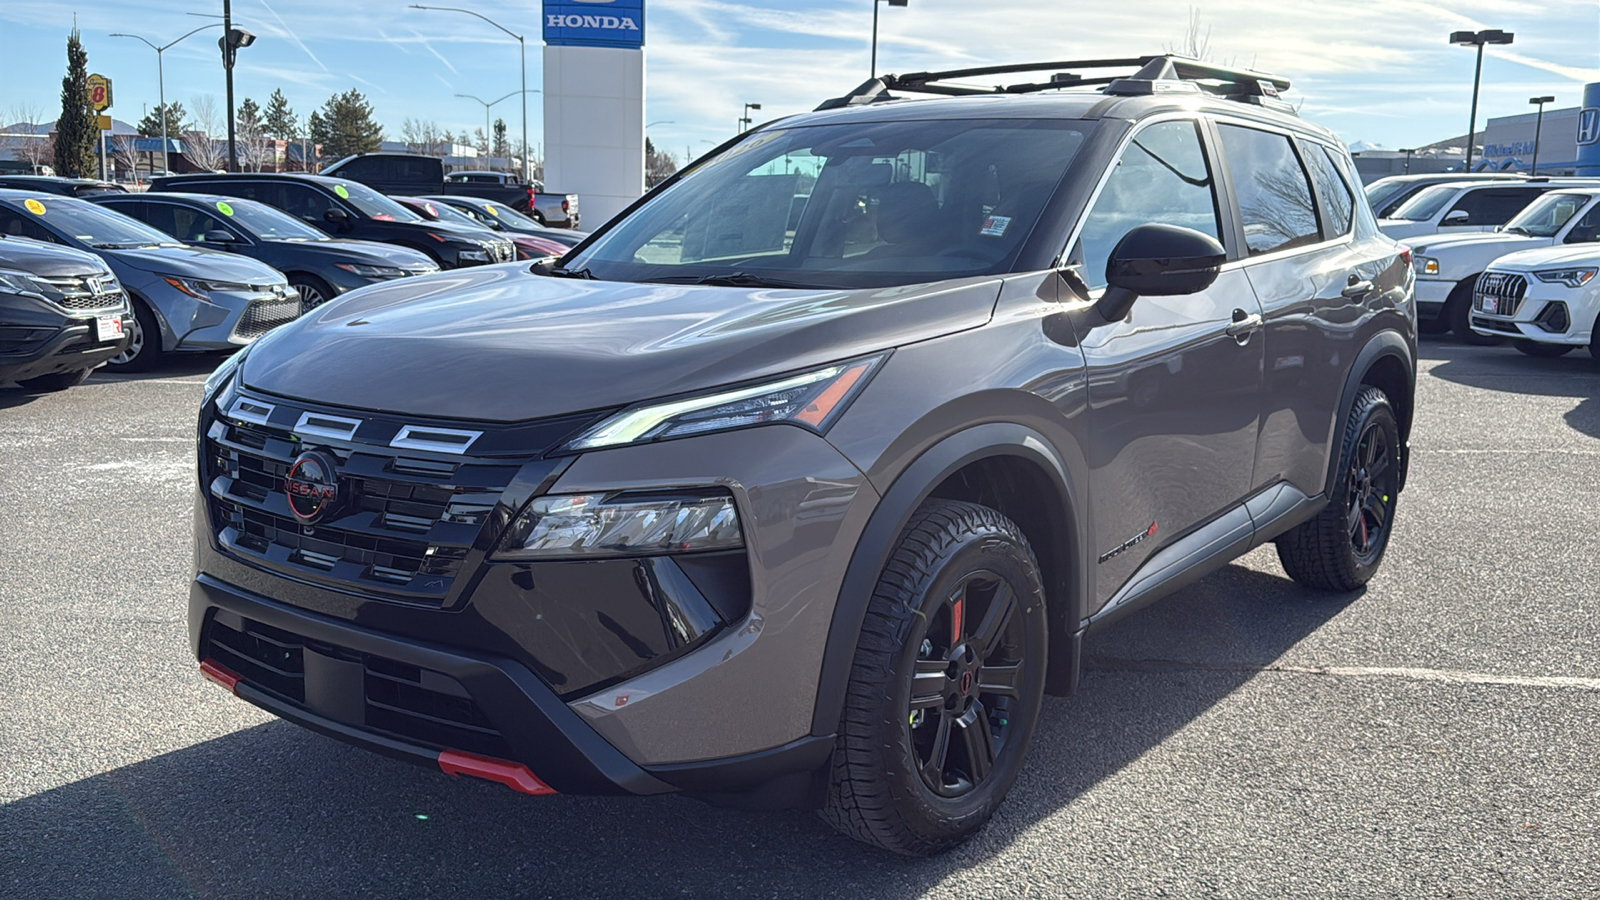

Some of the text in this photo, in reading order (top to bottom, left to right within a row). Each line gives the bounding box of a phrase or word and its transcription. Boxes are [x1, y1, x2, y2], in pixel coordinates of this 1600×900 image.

[547, 14, 639, 30] HONDA
[92, 86, 104, 103] 8
[285, 479, 334, 498] NISSAN
